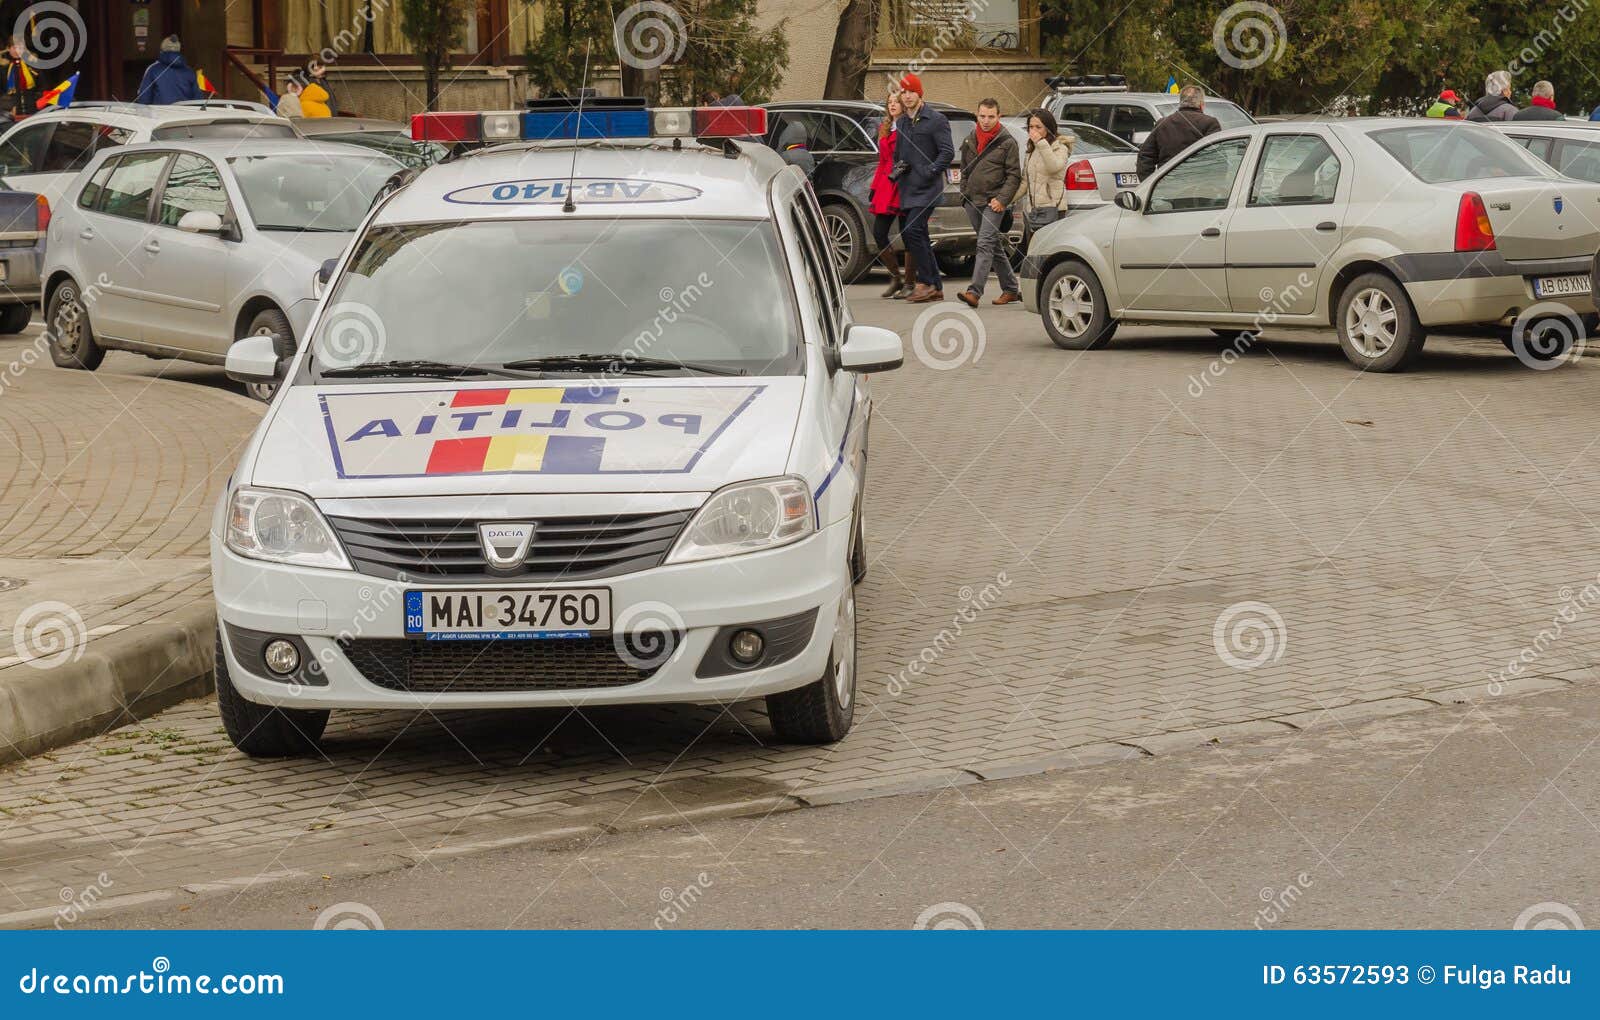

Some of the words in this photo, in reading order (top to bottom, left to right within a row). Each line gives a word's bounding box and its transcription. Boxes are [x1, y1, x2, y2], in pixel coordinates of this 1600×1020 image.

[1542, 279, 1555, 294] AB
[1557, 278, 1569, 292] 03
[431, 595, 483, 627] MAI
[497, 593, 600, 626] 34760
[408, 615, 422, 628] RO
